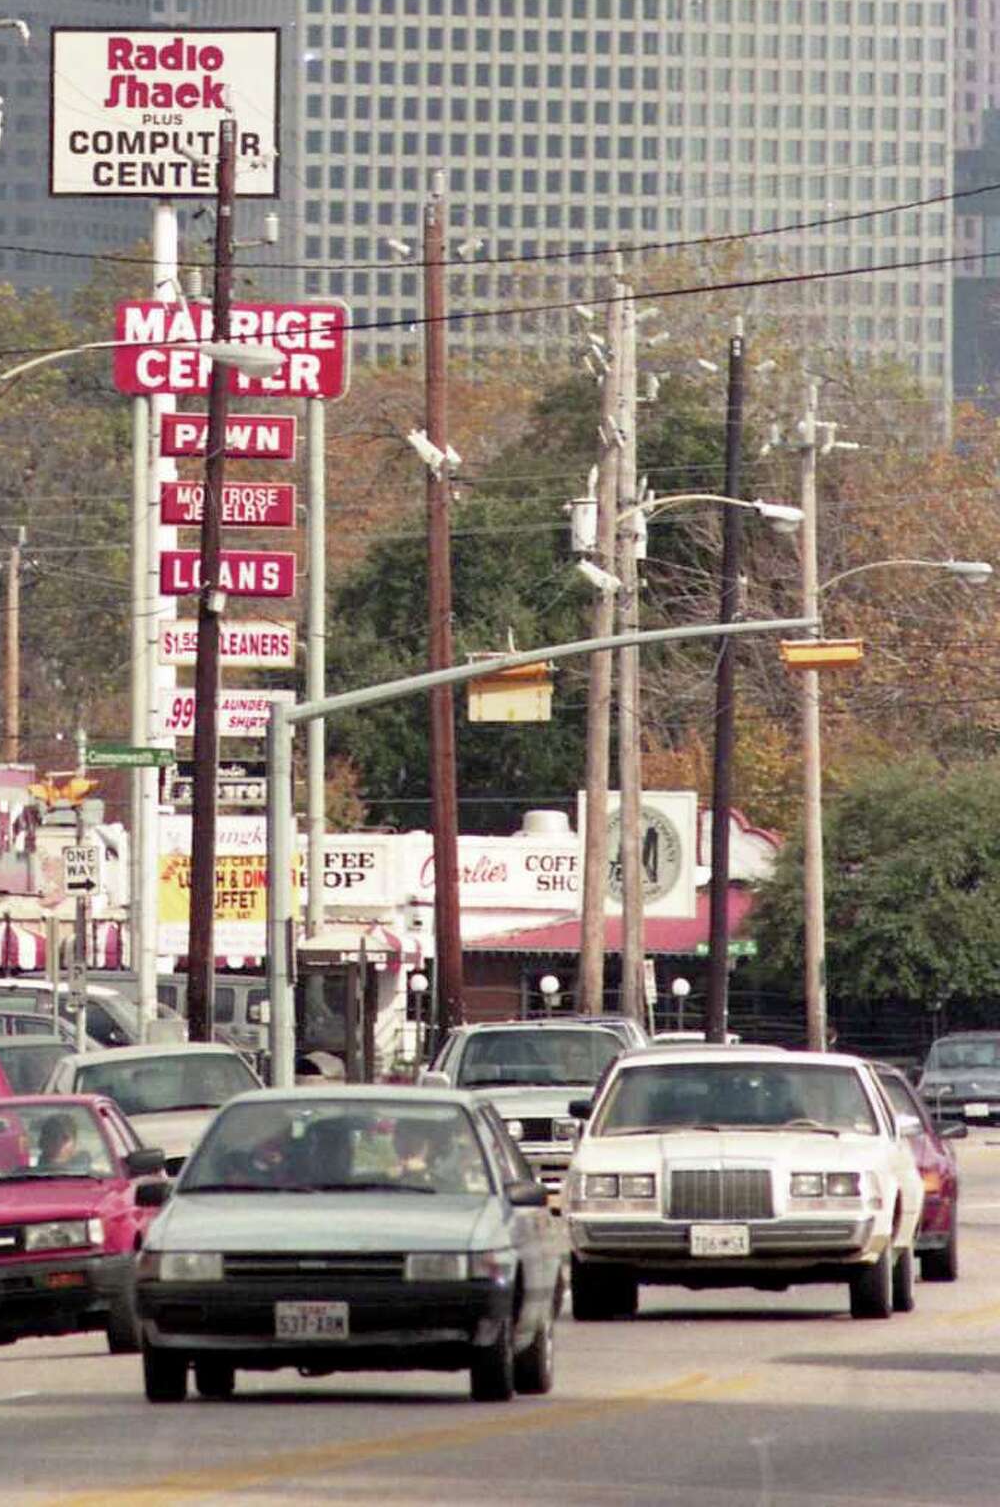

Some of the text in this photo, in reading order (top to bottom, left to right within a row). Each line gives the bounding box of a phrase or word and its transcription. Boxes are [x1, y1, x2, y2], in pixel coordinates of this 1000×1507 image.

[108, 37, 224, 71] Radio
[104, 75, 226, 109] Shack
[142, 113, 183, 125] PLUS
[69, 131, 260, 156] COMPUTR
[92, 161, 219, 187] CENTE
[177, 487, 279, 506] MOTROSE
[183, 504, 268, 522] JEELRY
[217, 633, 290, 656] LEANERS
[67, 849, 96, 862] ONE
[525, 855, 578, 873] COFF
[67, 865, 97, 876] WAY
[537, 874, 578, 892] SHO
[214, 891, 257, 909] UFFET
